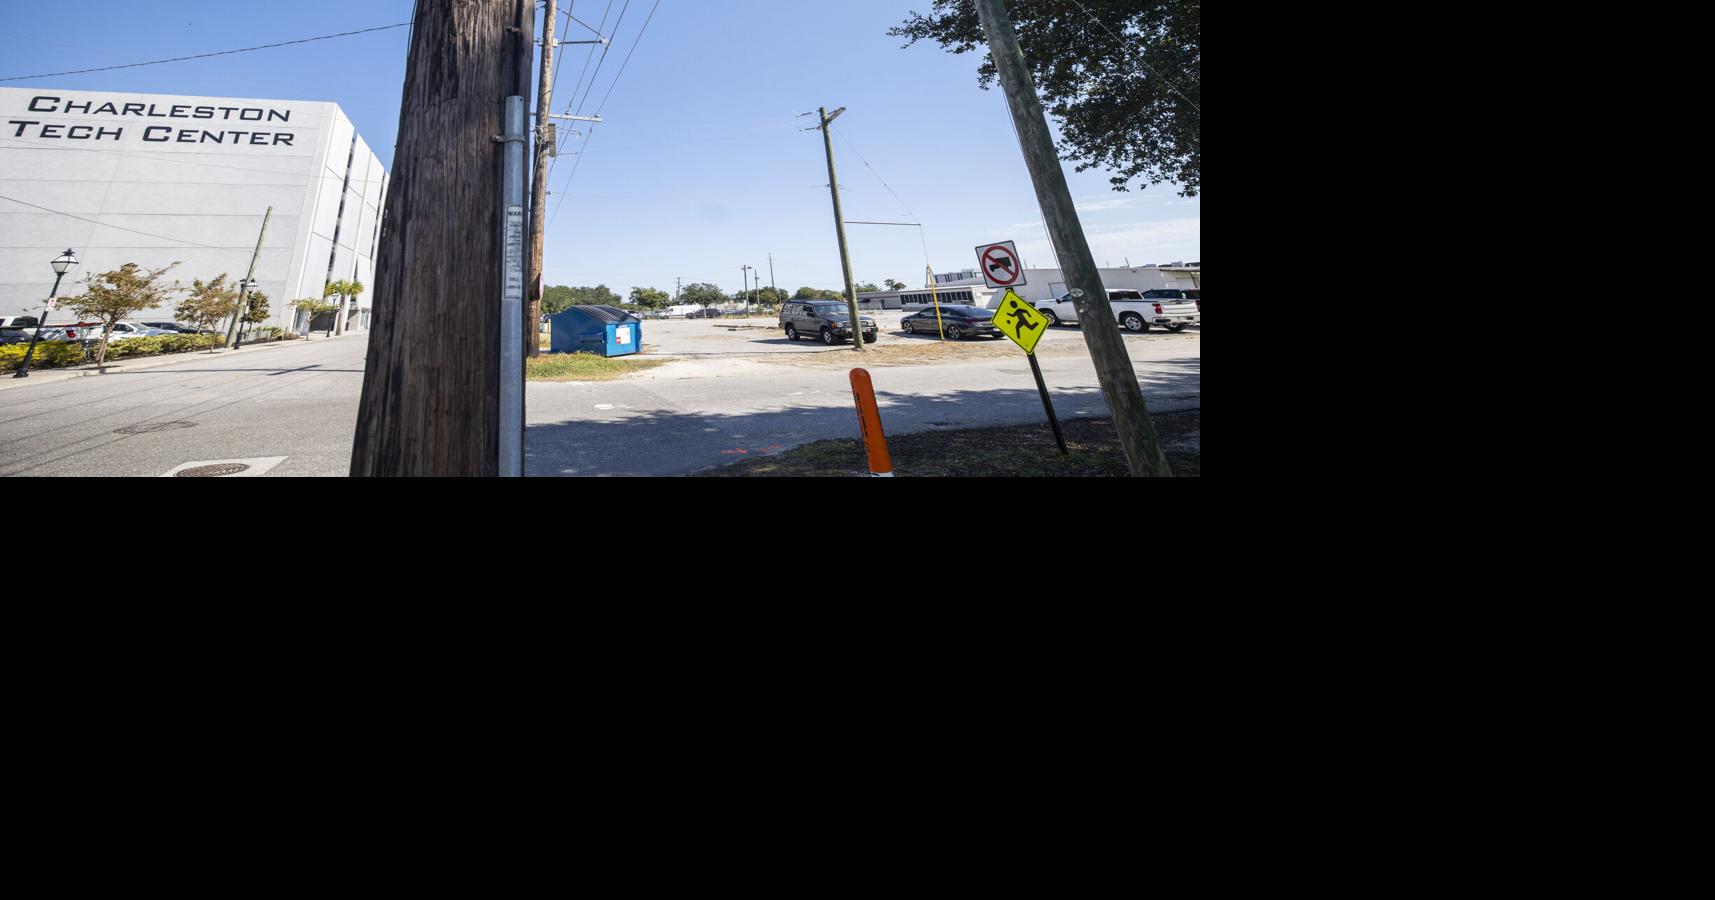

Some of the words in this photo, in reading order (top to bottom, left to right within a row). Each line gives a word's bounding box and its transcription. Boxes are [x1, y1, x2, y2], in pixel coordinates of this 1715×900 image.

[27, 96, 292, 122] CHARLESTON
[8, 120, 123, 141] TECH
[142, 126, 294, 146] CENTER
